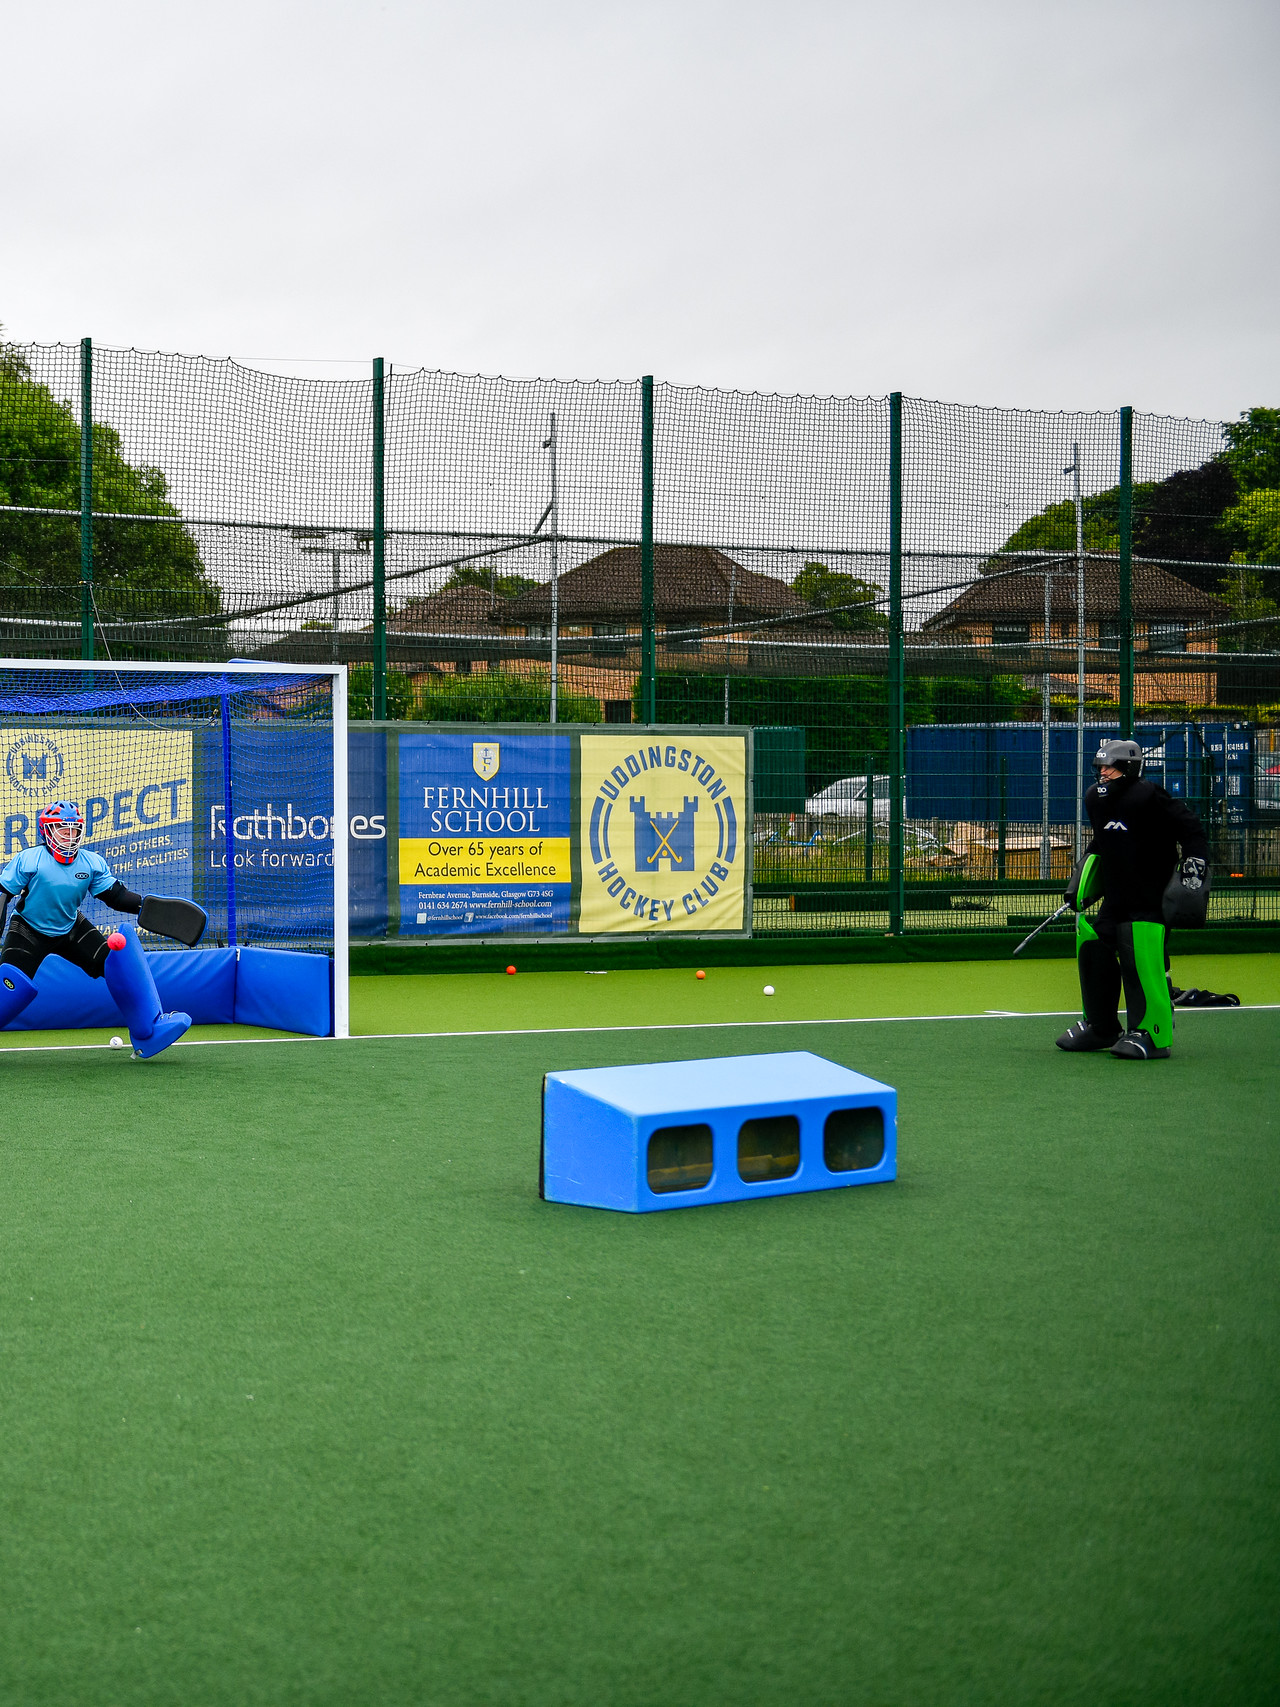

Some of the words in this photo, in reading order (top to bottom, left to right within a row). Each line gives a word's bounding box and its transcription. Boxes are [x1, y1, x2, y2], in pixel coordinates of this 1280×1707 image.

[599, 745, 727, 801] UDDINGSTON
[423, 786, 549, 809] FERNHILL
[3, 778, 187, 856] RPECT
[430, 810, 541, 833] SCHOOL
[105, 845, 126, 858] FOR
[113, 861, 133, 874] THE
[136, 848, 189, 869] FACILITIES
[428, 841, 464, 857] Over
[468, 841, 484, 856] 65
[489, 843, 524, 860] years
[529, 841, 543, 856] of
[414, 863, 481, 878] Academic
[486, 861, 556, 877] Excellence
[447, 891, 471, 899] Avenue,
[501, 890, 526, 899] Glasgow
[527, 890, 540, 898] G73
[598, 861, 675, 921] HOCKEY
[682, 861, 729, 915] CLUB
[418, 901, 435, 910] 0141
[437, 901, 450, 909] 634
[451, 901, 468, 909] 2674
[469, 899, 552, 909] www.fernhill-school.com
